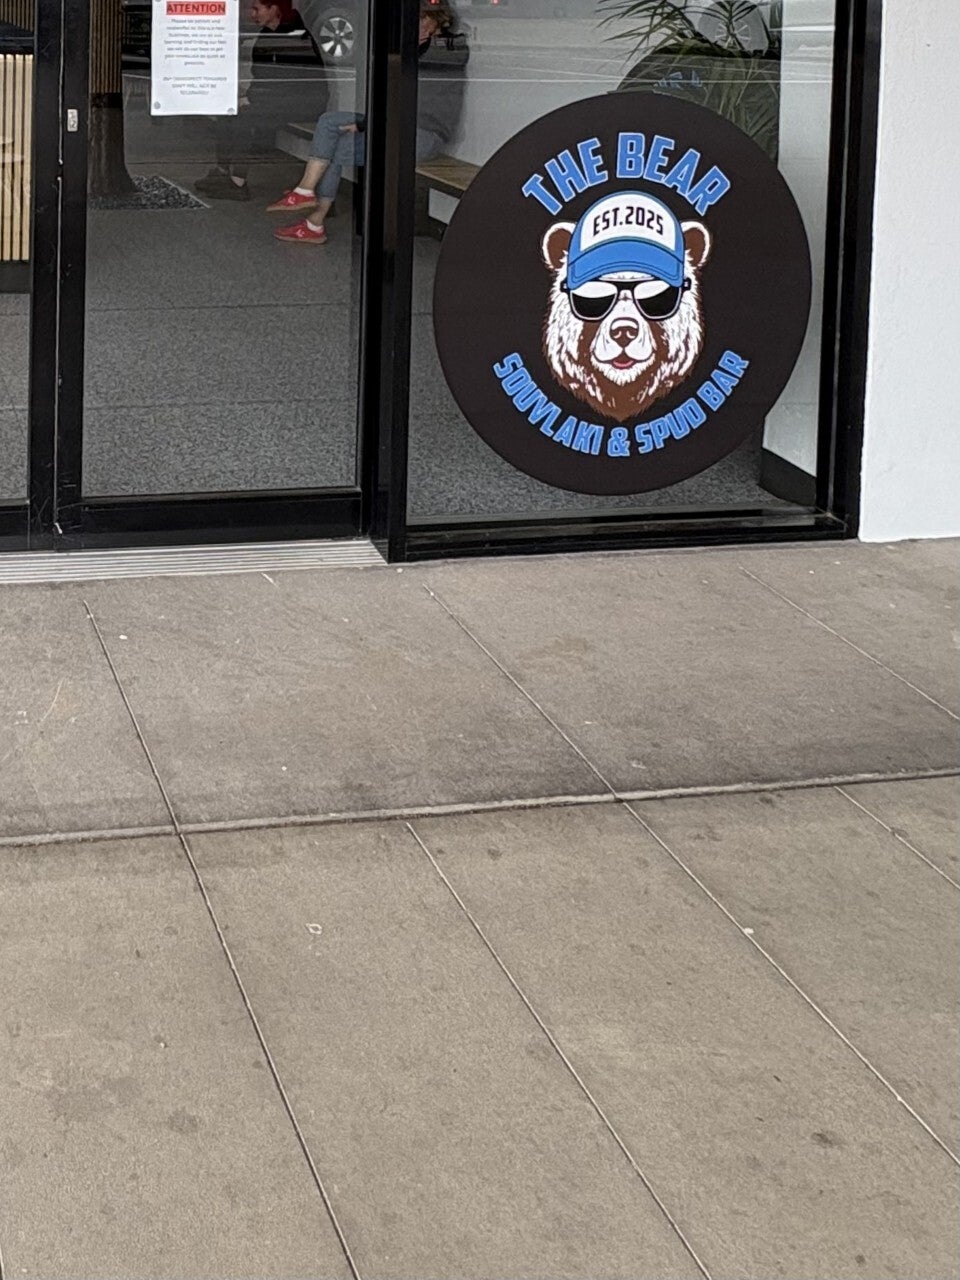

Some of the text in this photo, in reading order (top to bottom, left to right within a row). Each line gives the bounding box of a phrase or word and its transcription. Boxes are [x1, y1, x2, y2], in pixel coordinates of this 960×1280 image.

[166, 2, 226, 14] ATTENTION
[521, 132, 731, 216] THE BEAR
[592, 206, 664, 237] EST.2025
[493, 349, 750, 457] SOUVLAKI & SPUD BAR
